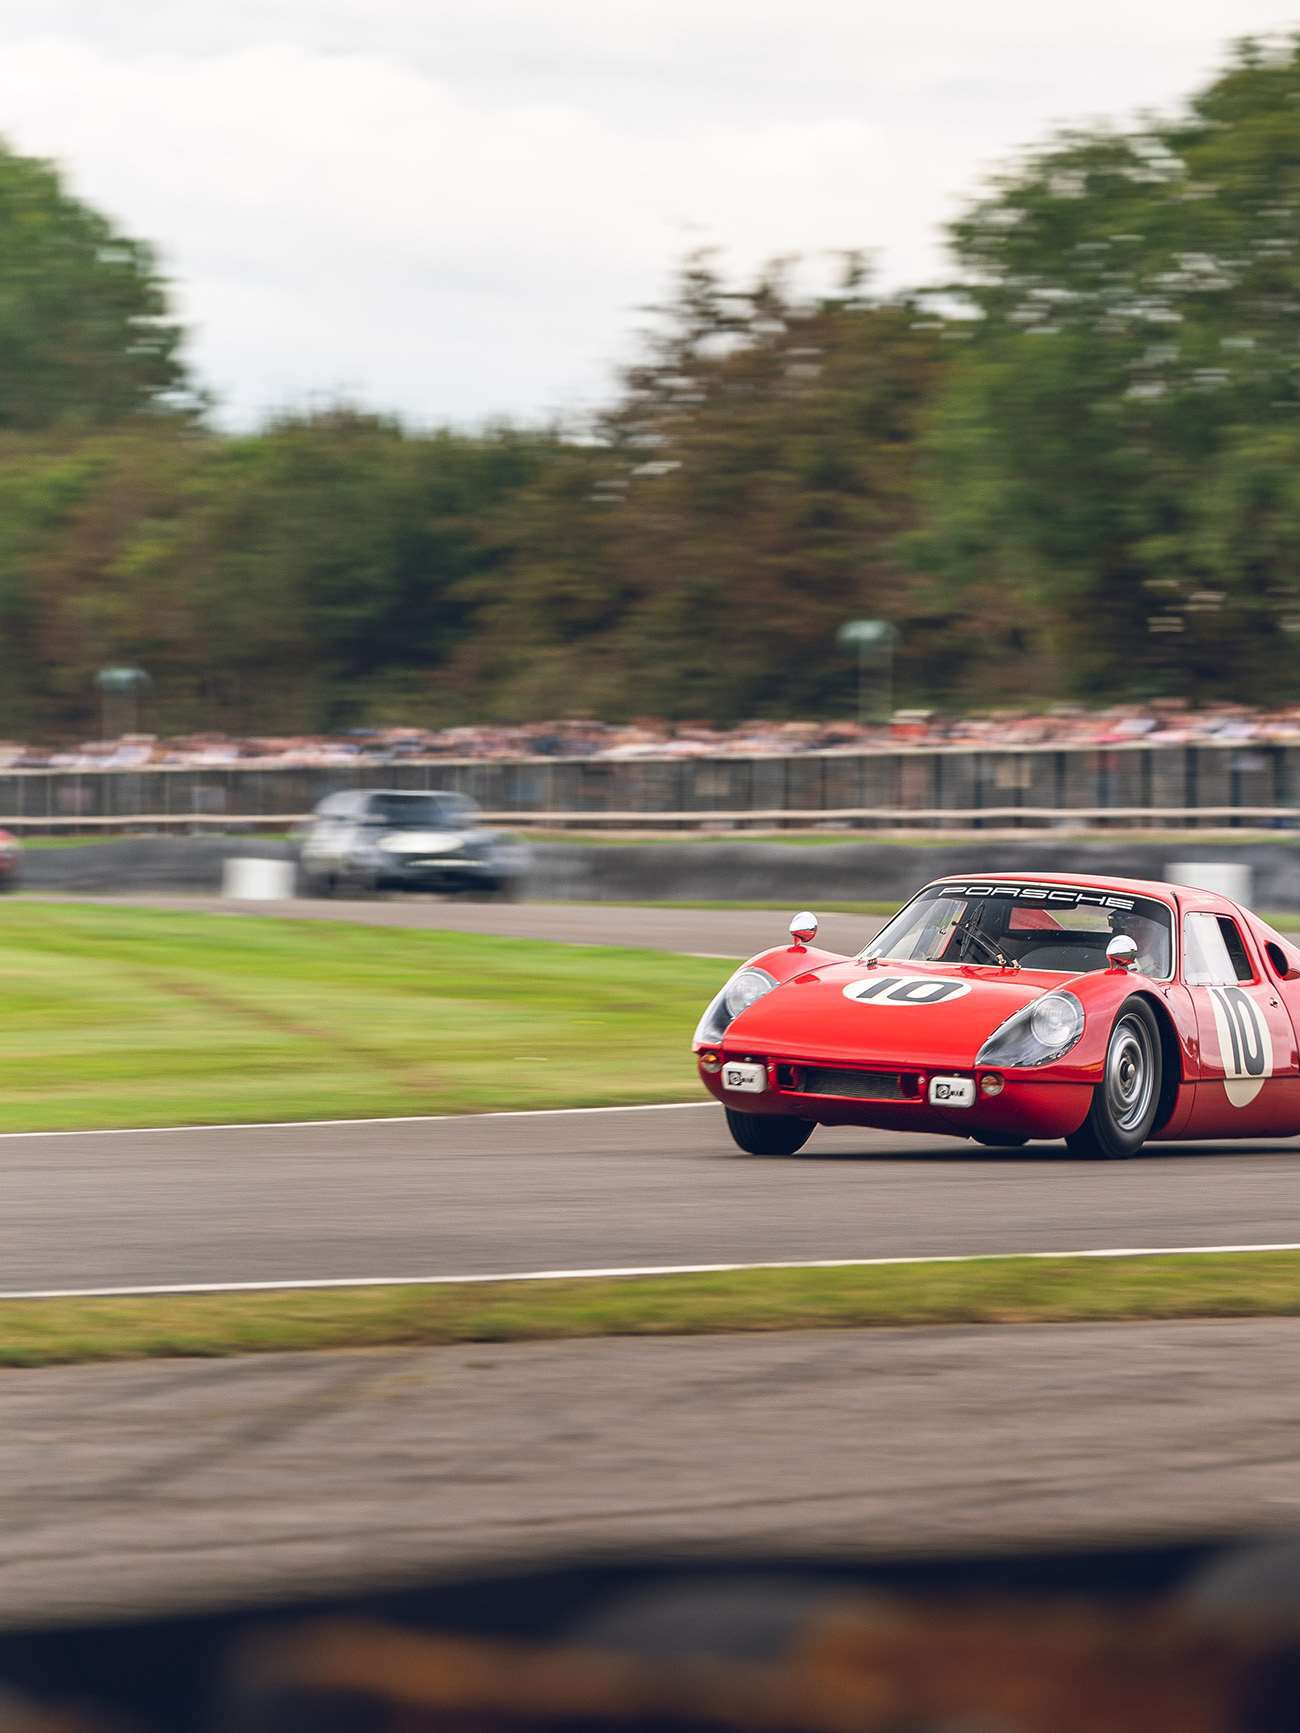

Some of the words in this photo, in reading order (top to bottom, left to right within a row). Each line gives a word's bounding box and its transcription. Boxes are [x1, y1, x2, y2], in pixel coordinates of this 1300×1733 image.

[938, 886, 1135, 911] PORSCHE
[855, 978, 964, 1003] 10
[1211, 987, 1265, 1076] 10
